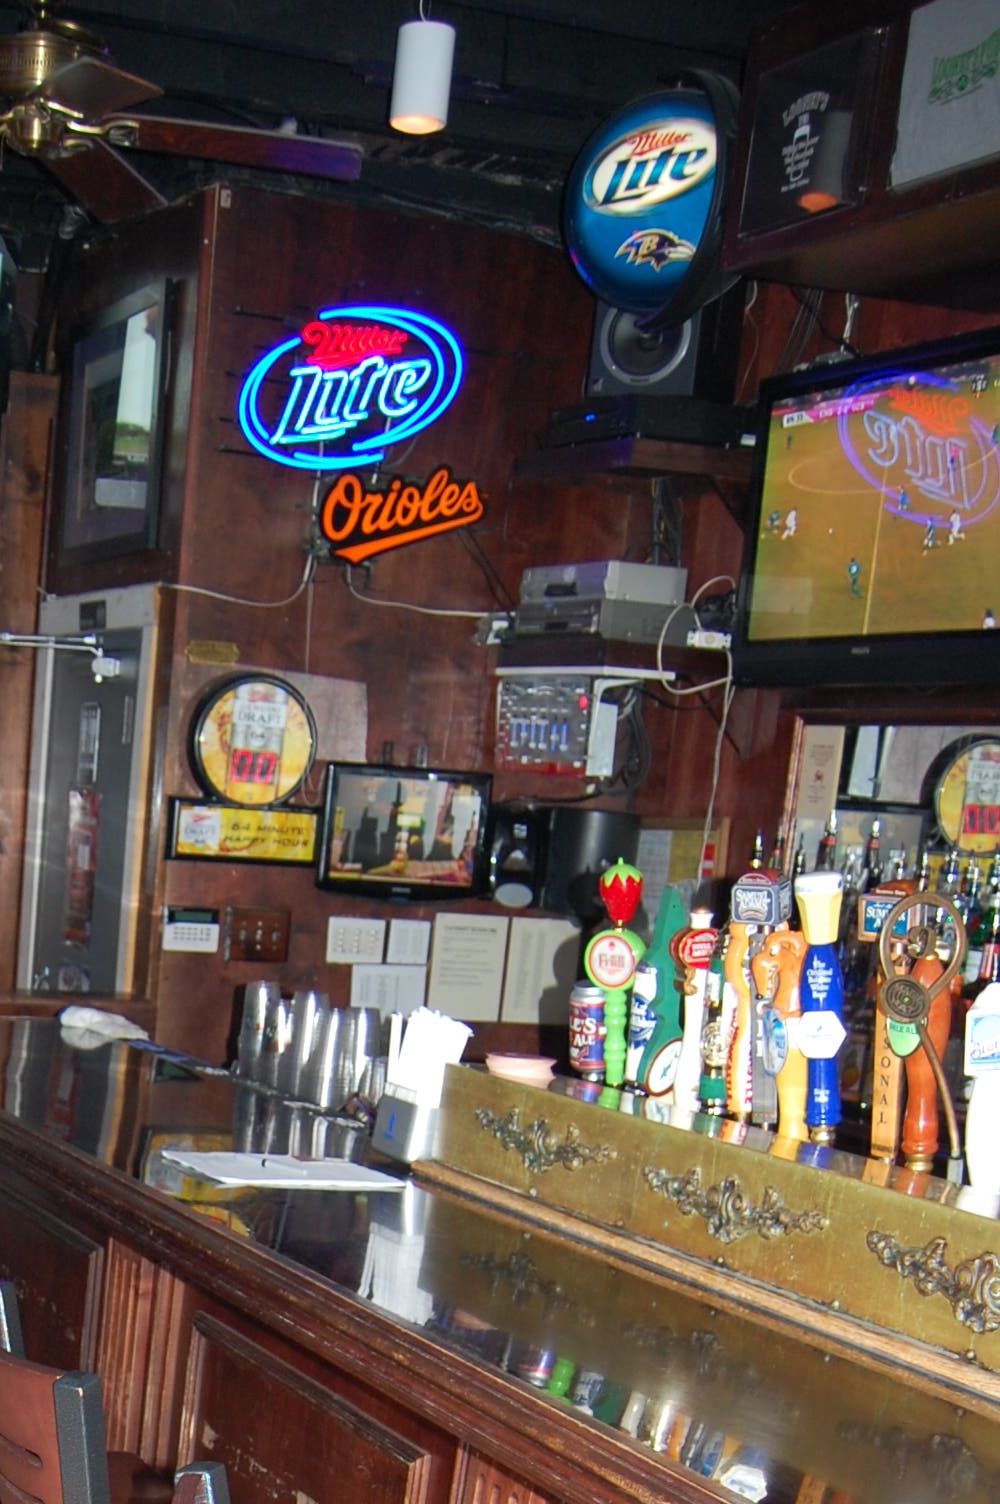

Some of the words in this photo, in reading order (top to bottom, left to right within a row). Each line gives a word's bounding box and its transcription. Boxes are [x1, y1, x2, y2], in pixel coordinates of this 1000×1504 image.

[627, 131, 693, 157] Miller
[600, 147, 707, 206] Lite
[302, 320, 409, 370] Miller
[269, 355, 432, 445] Lite
[323, 469, 485, 546] Orioles
[256, 823, 305, 836] MINUTE
[273, 838, 310, 848] HOUR
[569, 1017, 598, 1035] LE'S
[574, 1034, 597, 1046] ALE
